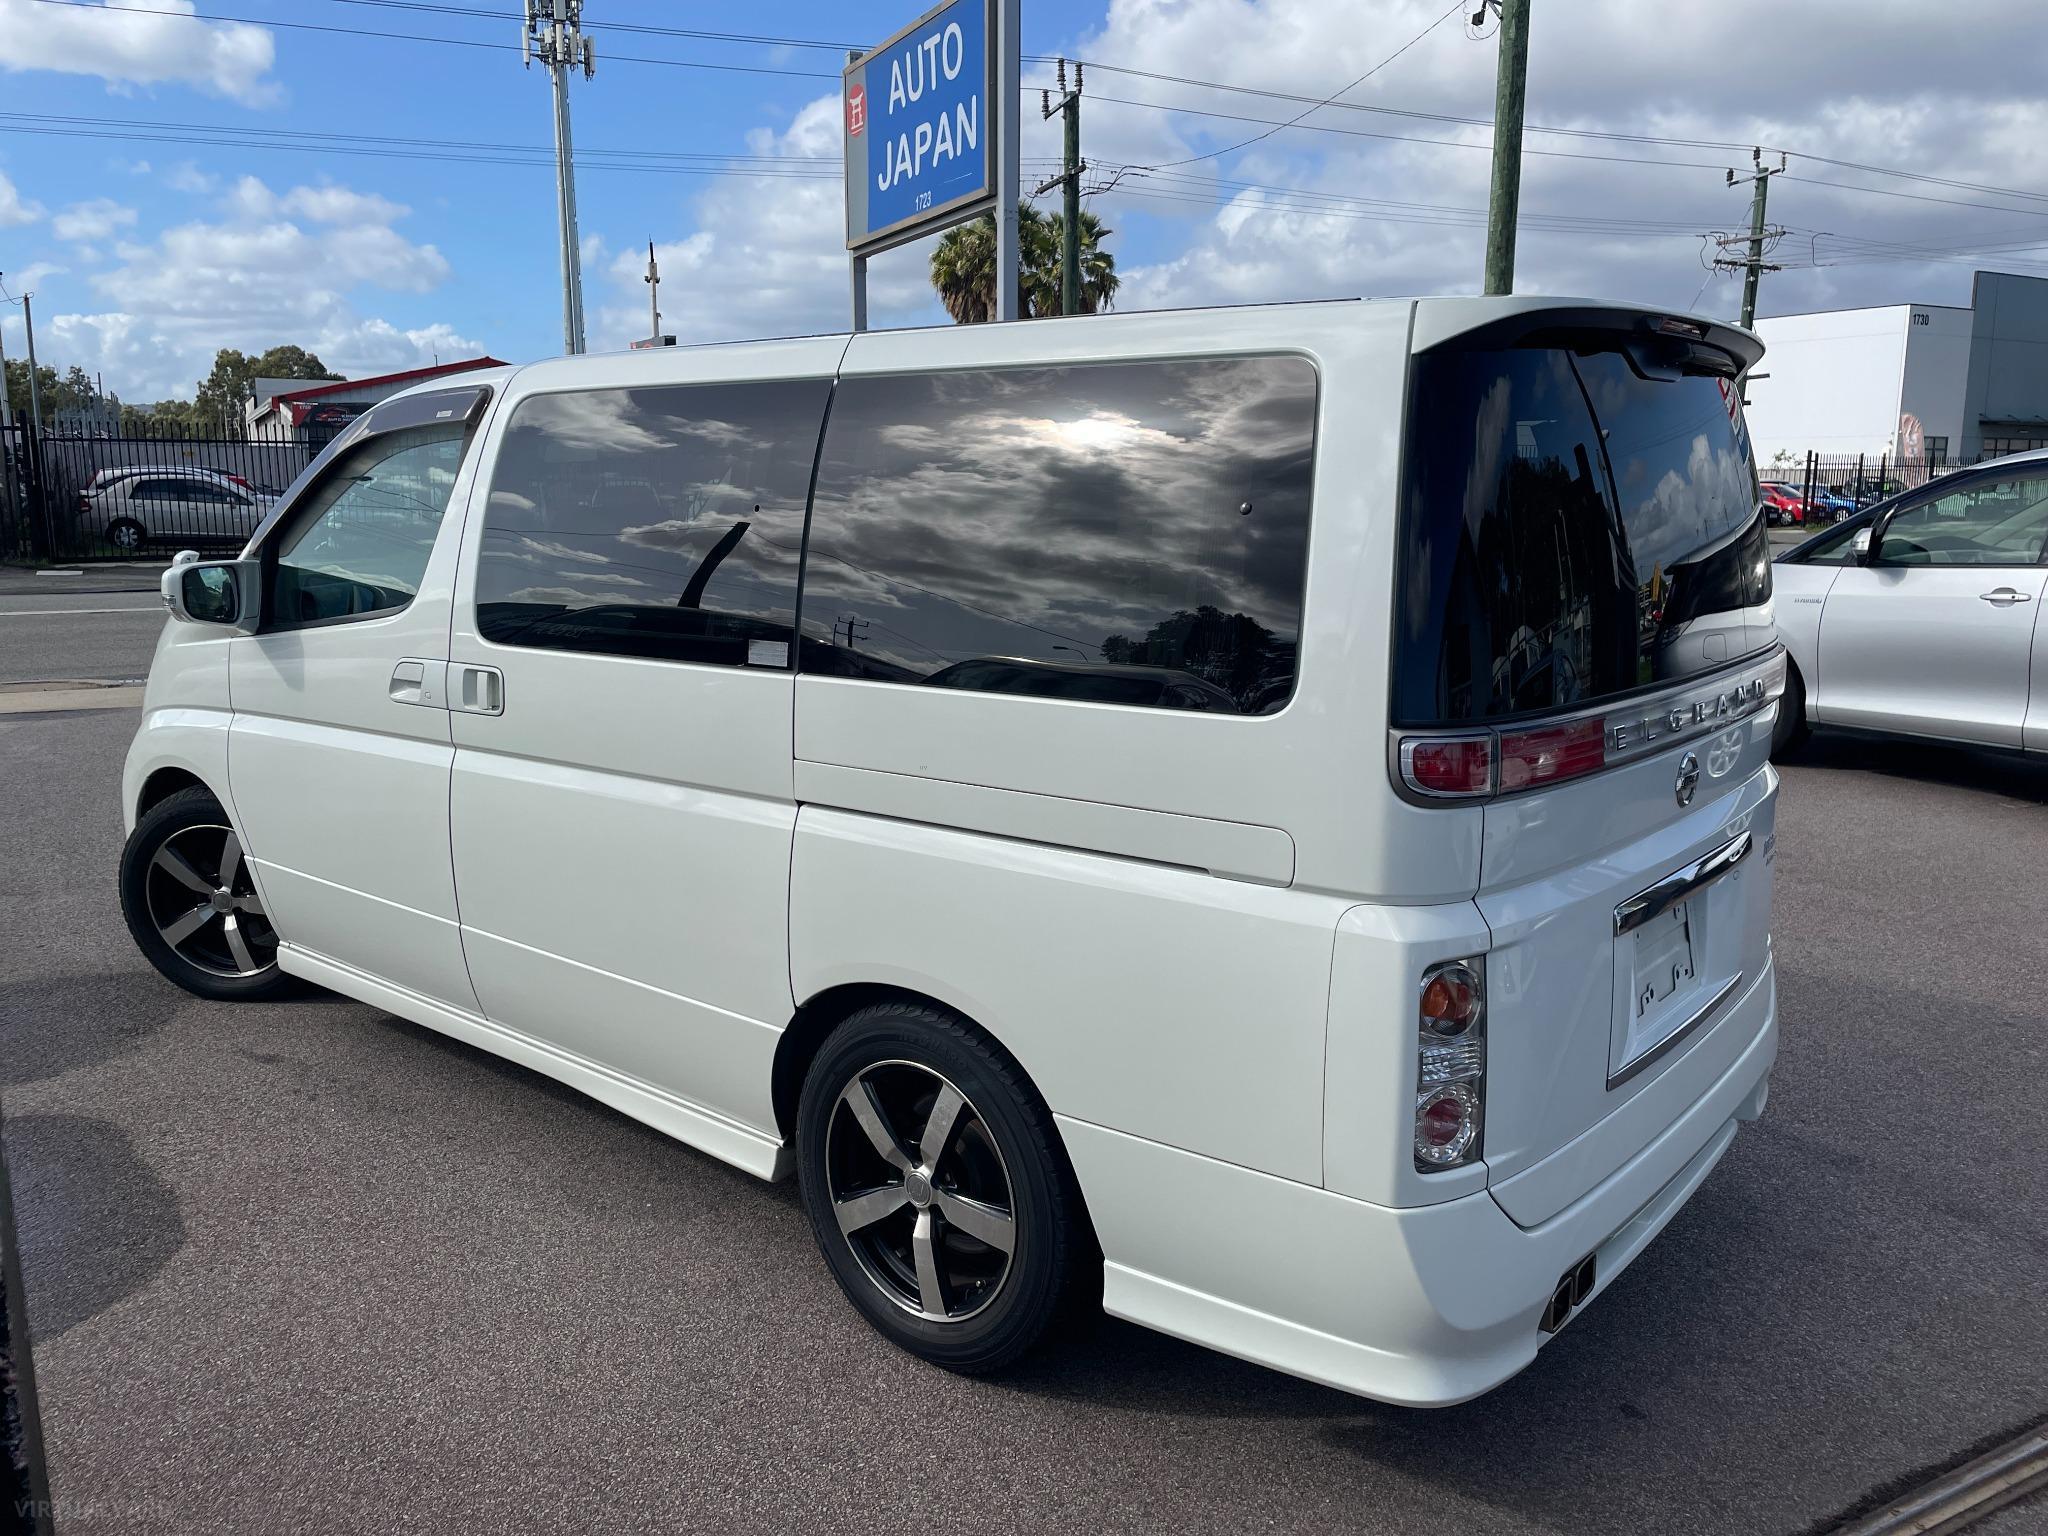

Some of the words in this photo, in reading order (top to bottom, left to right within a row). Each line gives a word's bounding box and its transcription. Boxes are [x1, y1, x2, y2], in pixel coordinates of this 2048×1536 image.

[889, 22, 963, 115] AUTO
[878, 94, 977, 191] JAPAN
[915, 190, 931, 211] 1723
[1912, 313, 1930, 326] 1730
[1613, 679, 1766, 750] ELGRAND
